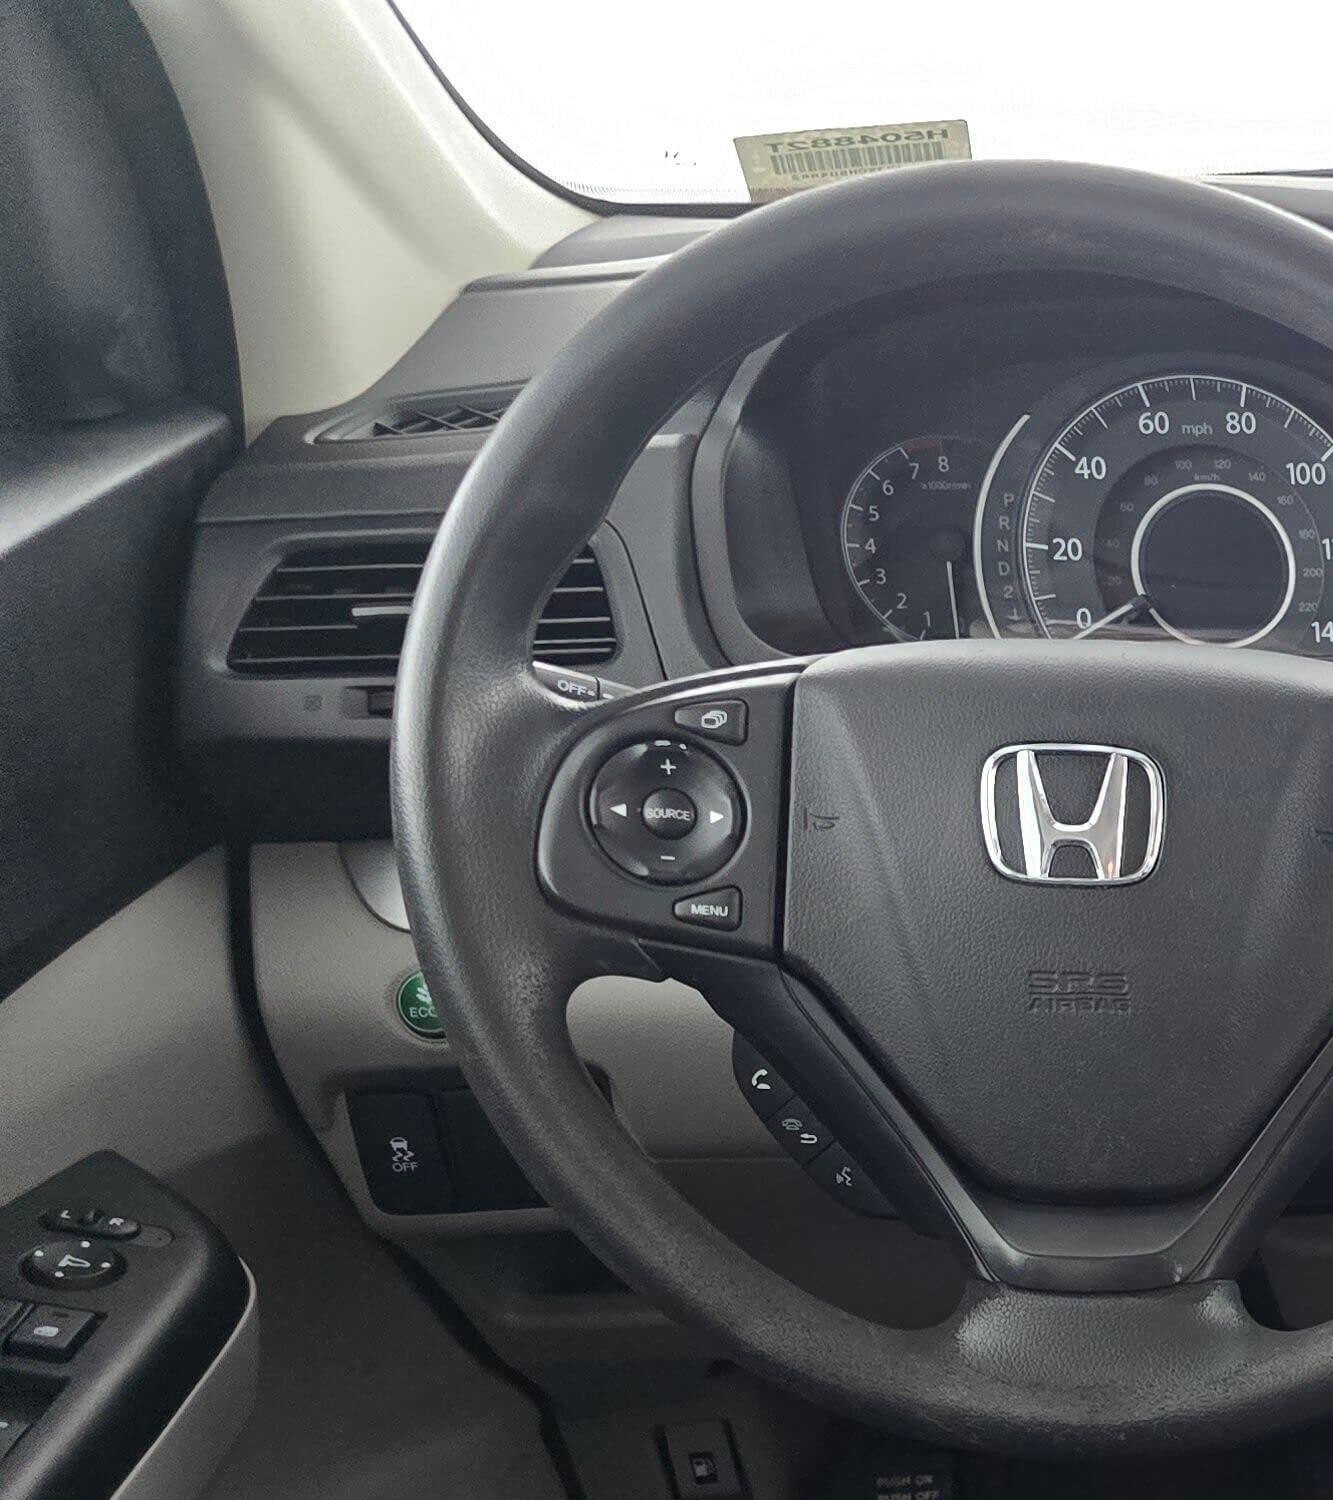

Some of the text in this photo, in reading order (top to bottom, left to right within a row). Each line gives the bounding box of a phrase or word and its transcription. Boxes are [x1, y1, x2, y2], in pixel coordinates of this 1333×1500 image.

[1138, 411, 1170, 436] 60
[1181, 422, 1213, 437] mph
[1225, 411, 1257, 436] 80
[908, 462, 920, 481] 7
[937, 455, 950, 473] 8
[1075, 456, 1107, 482] 40
[1285, 461, 1327, 487] 100
[882, 480, 895, 497] 6
[1003, 493, 1014, 507] P
[868, 505, 880, 522] 5
[999, 515, 1010, 530] R
[864, 538, 877, 554] 4
[997, 540, 1009, 553] N
[1052, 538, 1084, 562] 20
[875, 569, 887, 585] 3
[998, 561, 1011, 576] D
[896, 592, 907, 609] 2
[1003, 585, 1014, 599] 2
[922, 610, 933, 628] 1
[1075, 607, 1093, 630] 0
[557, 678, 588, 696] OFF
[646, 807, 691, 822] SOURCE
[690, 903, 729, 918] MENU
[392, 1162, 418, 1172] OFF
